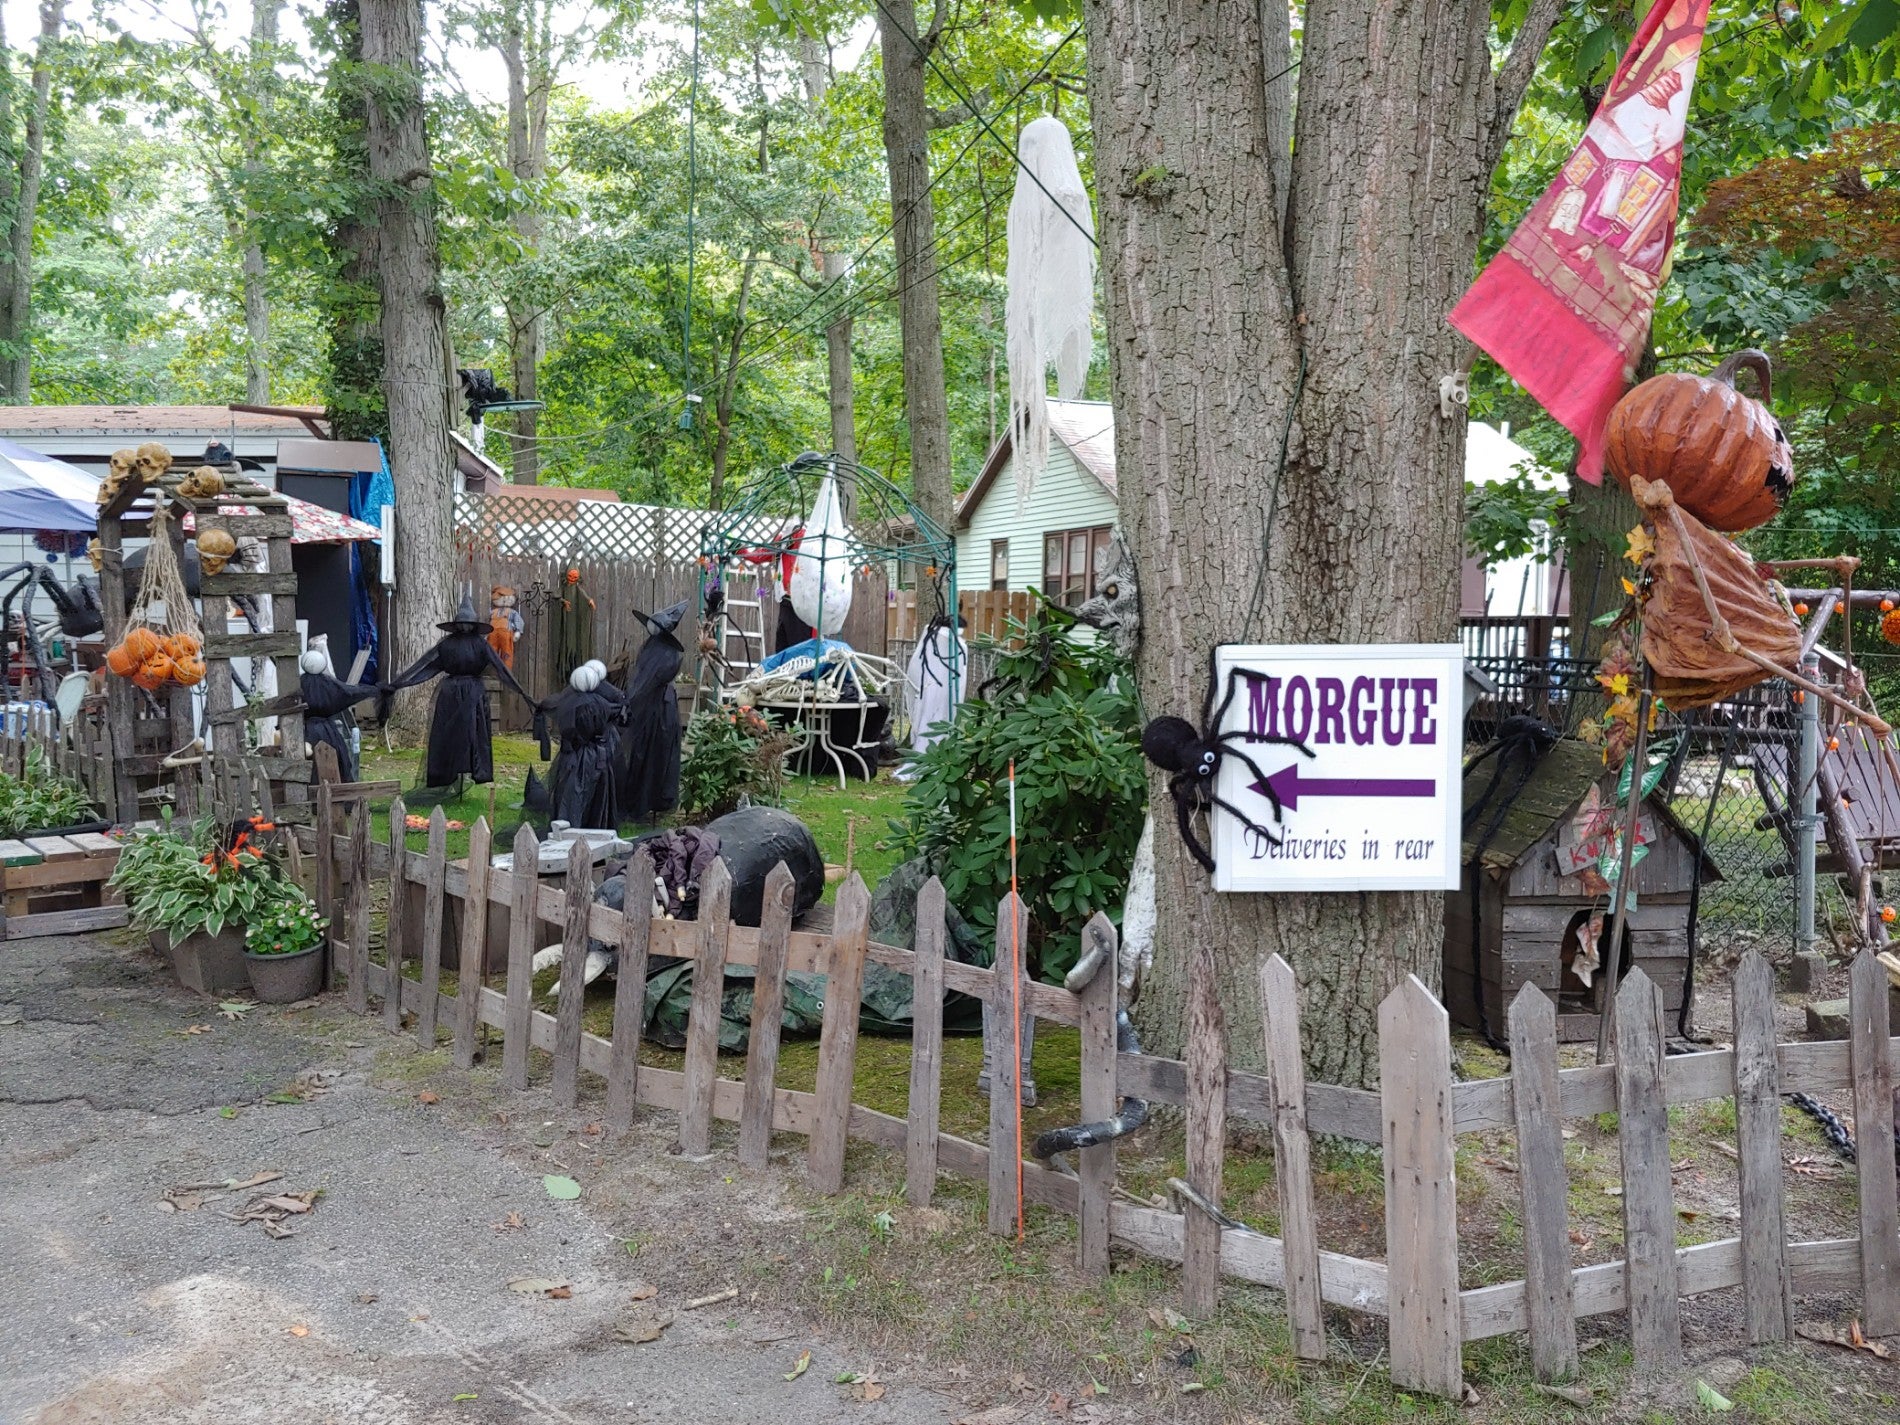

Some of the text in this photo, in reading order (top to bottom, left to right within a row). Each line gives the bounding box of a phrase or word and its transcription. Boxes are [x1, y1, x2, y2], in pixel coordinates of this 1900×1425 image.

[1245, 675, 1438, 746] MORGUE
[1243, 824, 1435, 860] Deliveries in rear
